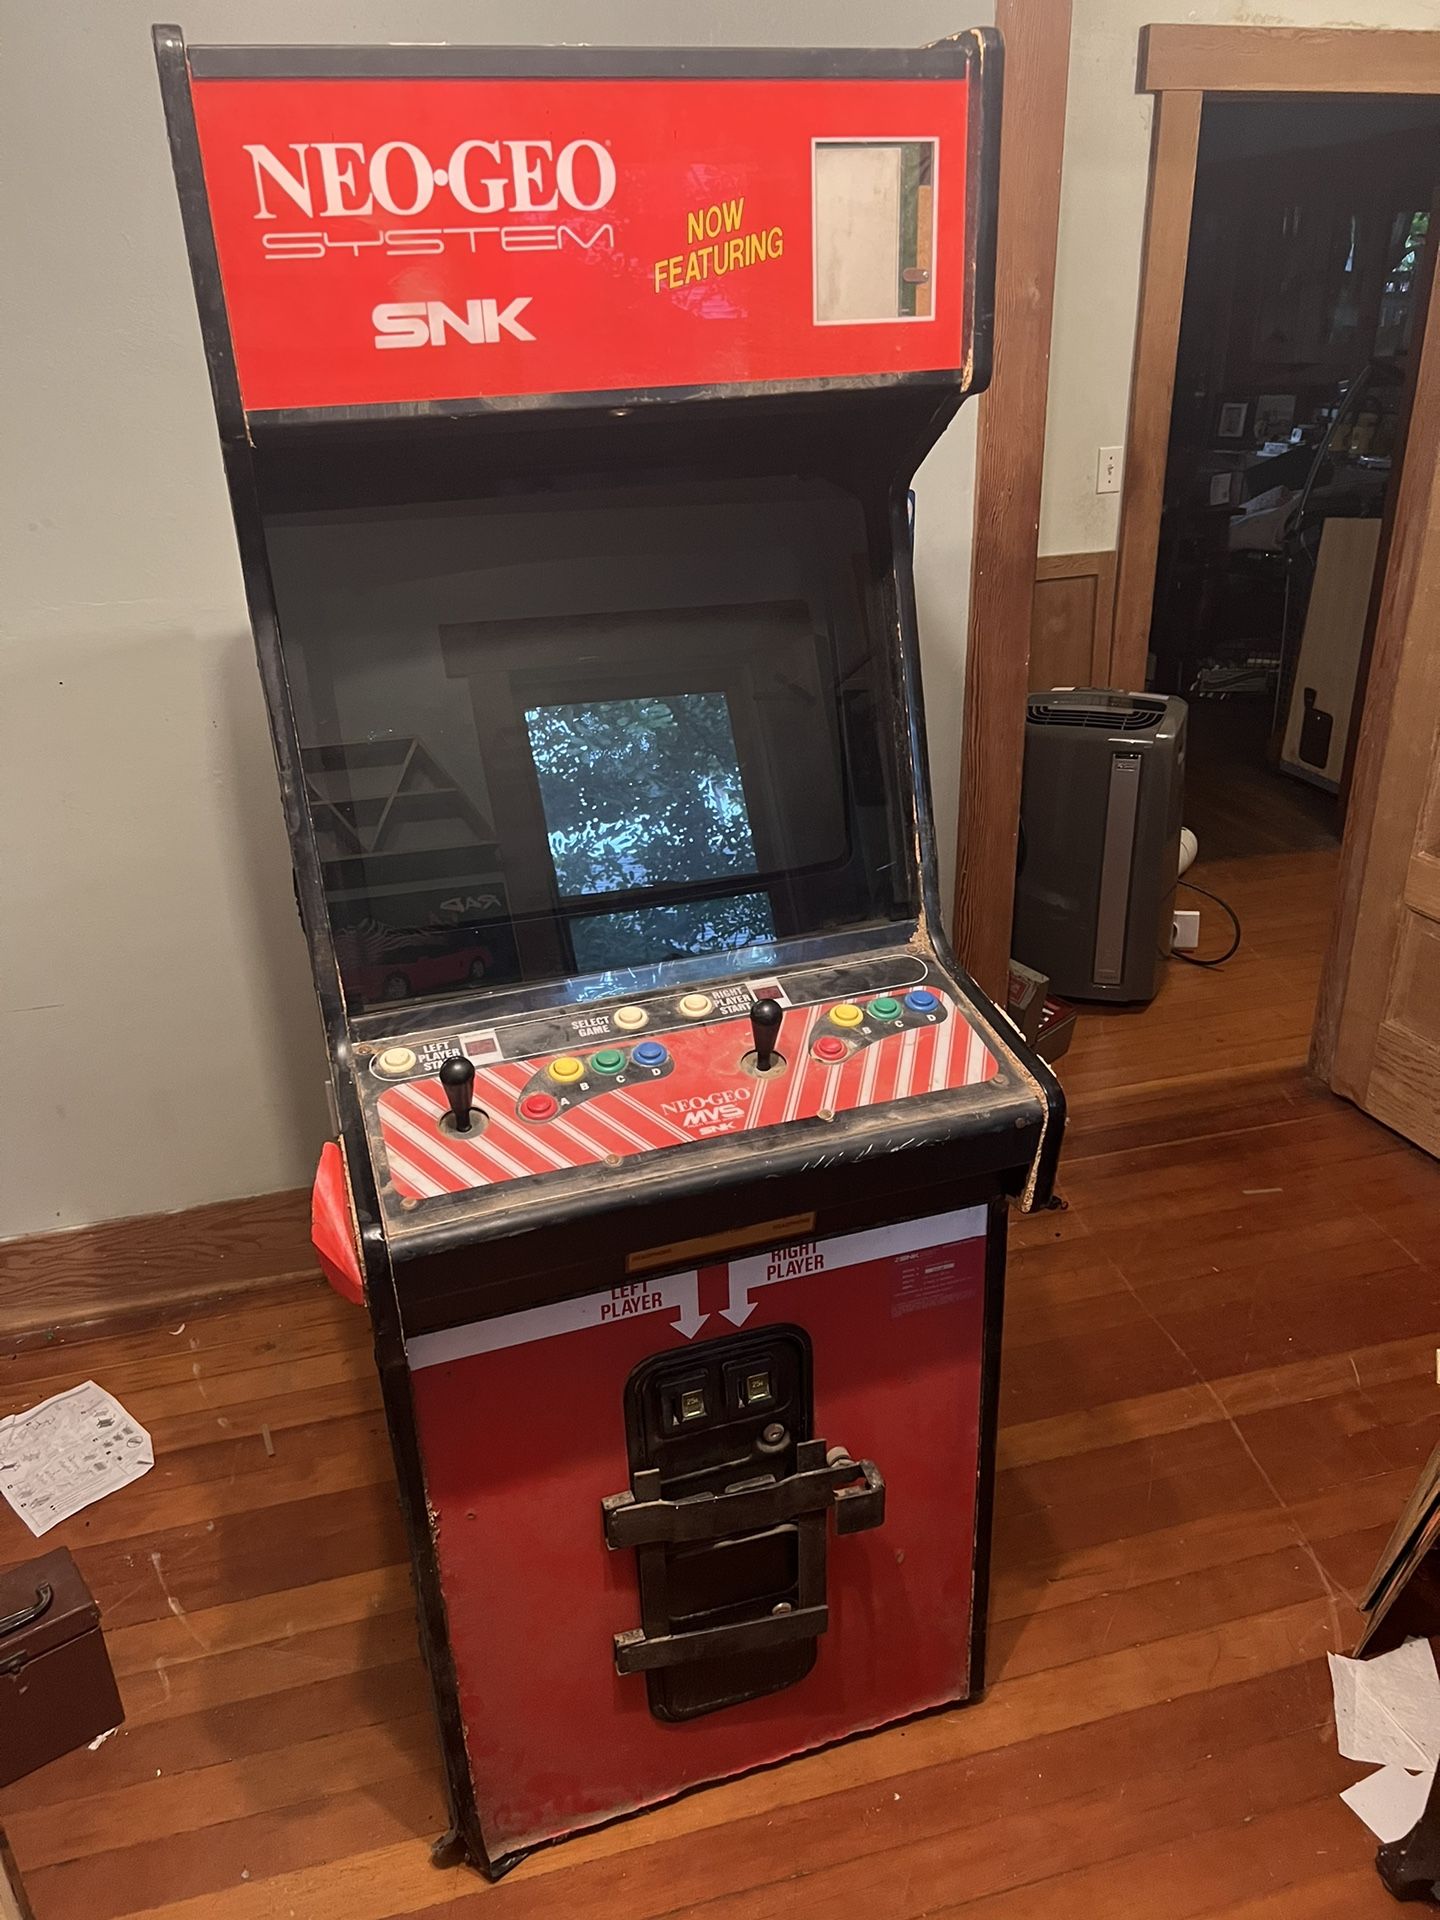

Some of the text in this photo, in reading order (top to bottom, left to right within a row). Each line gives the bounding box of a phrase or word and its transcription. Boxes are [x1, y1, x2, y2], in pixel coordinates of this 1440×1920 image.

[686, 197, 745, 243] NOW
[262, 223, 615, 260] SYSTEM
[653, 226, 784, 294] FEATURING
[371, 297, 537, 350] SNK
[712, 986, 743, 999] RIGHT
[713, 994, 752, 1008] PLAYER
[719, 1002, 752, 1015] START
[571, 1015, 610, 1031] SELECT
[894, 1020, 904, 1028] C
[926, 1014, 937, 1022] D
[578, 1024, 611, 1037] GAME
[422, 1041, 449, 1054] LEFT
[418, 1048, 461, 1063] PLAYER
[651, 1067, 661, 1076] D
[615, 1074, 626, 1084] C
[580, 1082, 590, 1091] B
[560, 1097, 571, 1106] A
[683, 1104, 745, 1127] MVS
[699, 1121, 737, 1135] SNK
[766, 1254, 825, 1281] PLAYER
[600, 1291, 663, 1320] PLAYER
